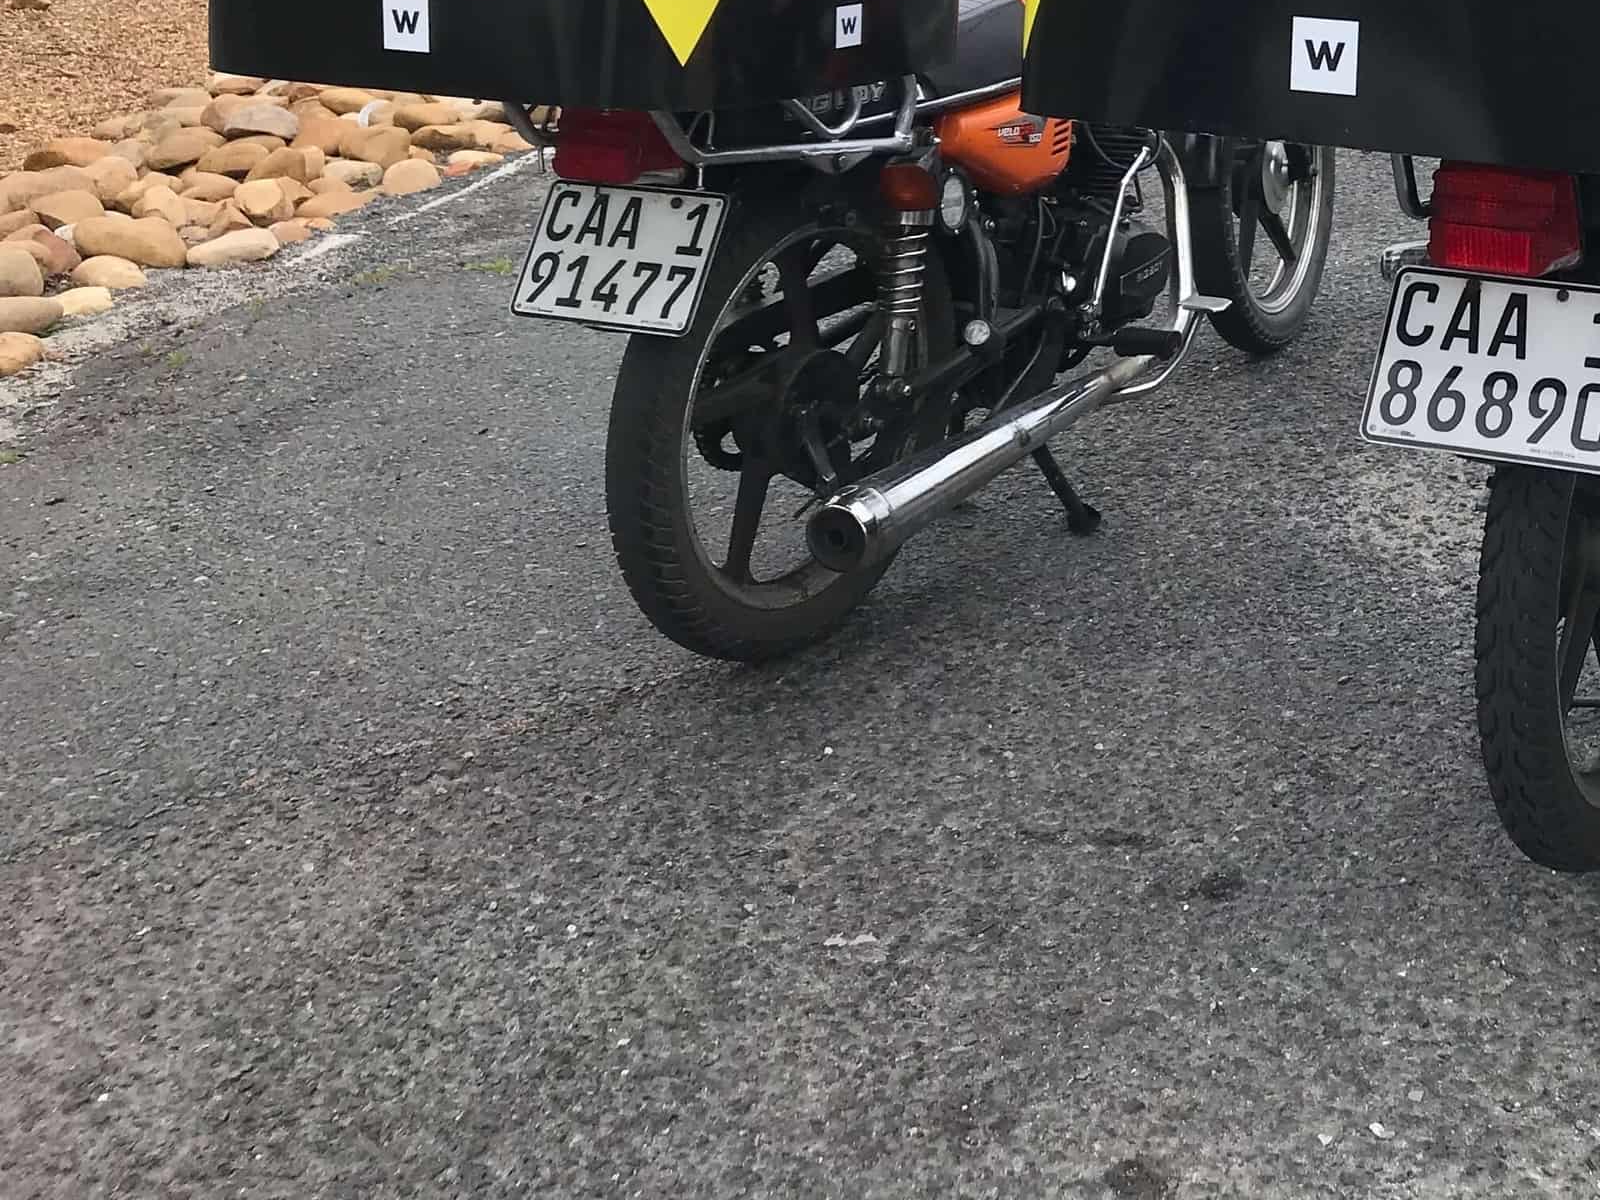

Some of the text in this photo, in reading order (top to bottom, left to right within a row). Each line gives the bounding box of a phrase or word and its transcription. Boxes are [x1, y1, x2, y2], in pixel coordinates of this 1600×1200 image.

[391, 9, 420, 34] W
[1305, 39, 1346, 72] W
[546, 191, 710, 256] CAA 1
[526, 250, 697, 319] 91477
[1396, 281, 1528, 360] CAA
